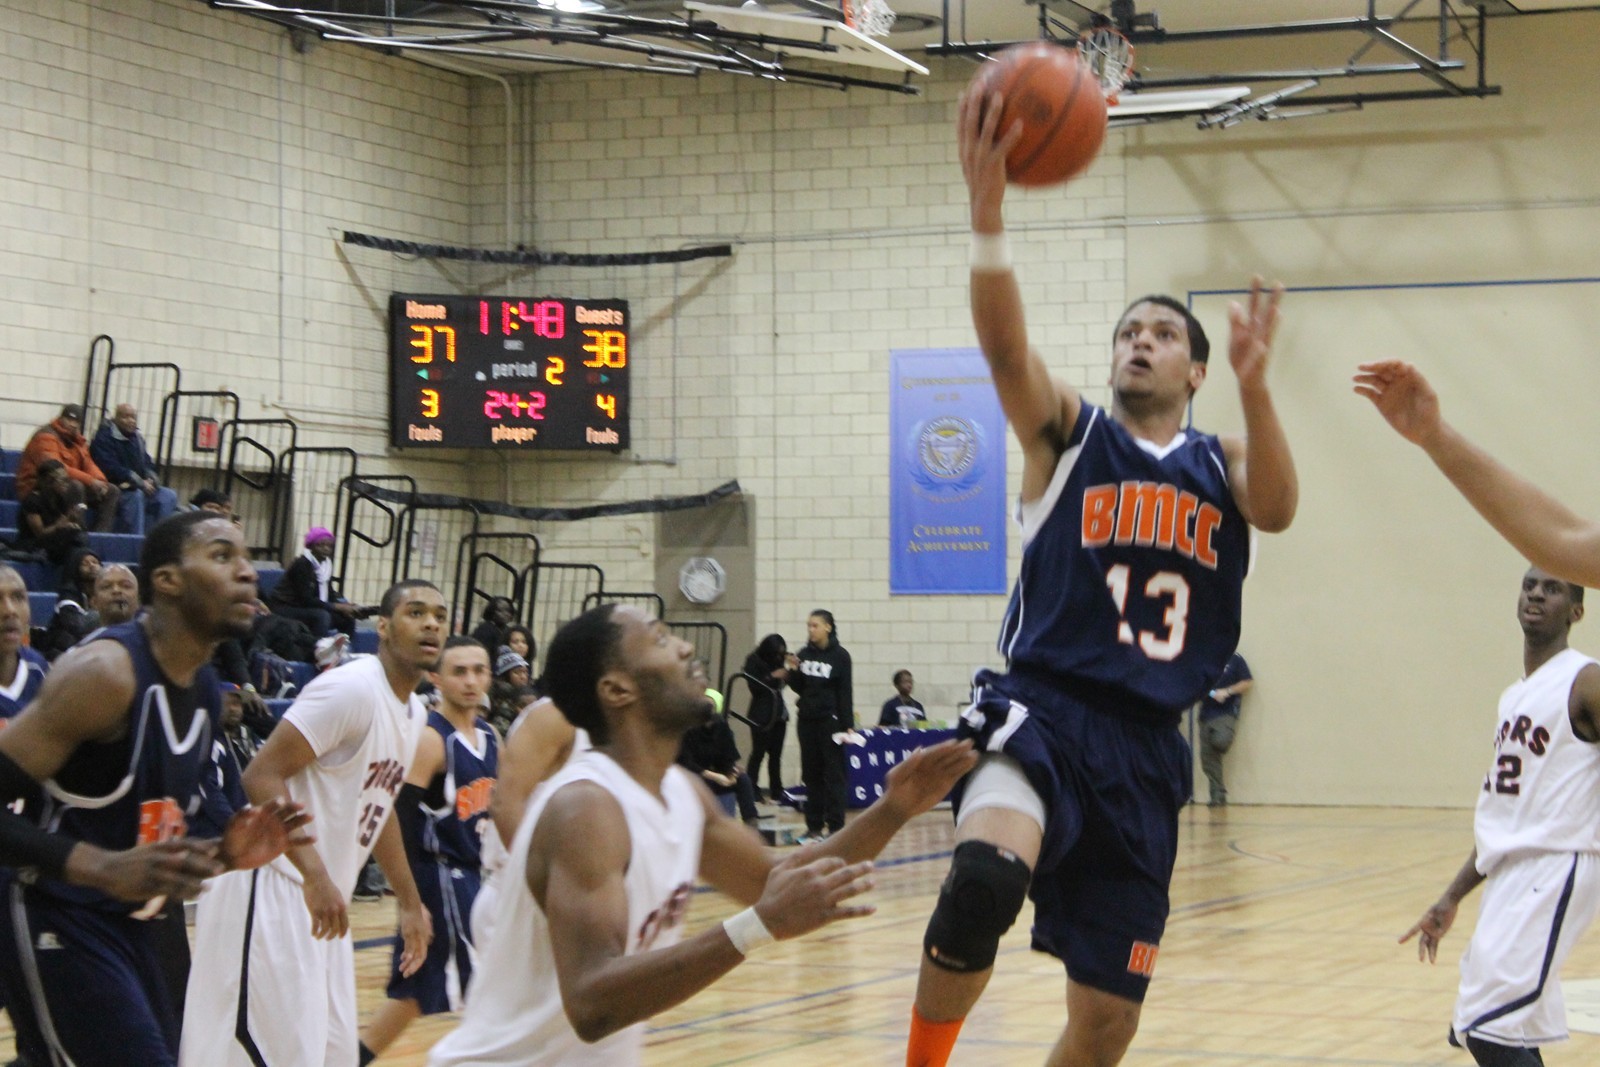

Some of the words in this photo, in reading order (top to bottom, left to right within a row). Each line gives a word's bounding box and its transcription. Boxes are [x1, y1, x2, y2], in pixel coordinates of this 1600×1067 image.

[479, 300, 565, 339] 11:48
[410, 325, 456, 364] 37
[582, 329, 626, 369] 38
[492, 361, 537, 379] period
[545, 356, 565, 385] 2
[421, 388, 440, 418] 3
[596, 394, 616, 419] 4
[1081, 479, 1223, 571] BMCC
[1106, 563, 1190, 661] 13
